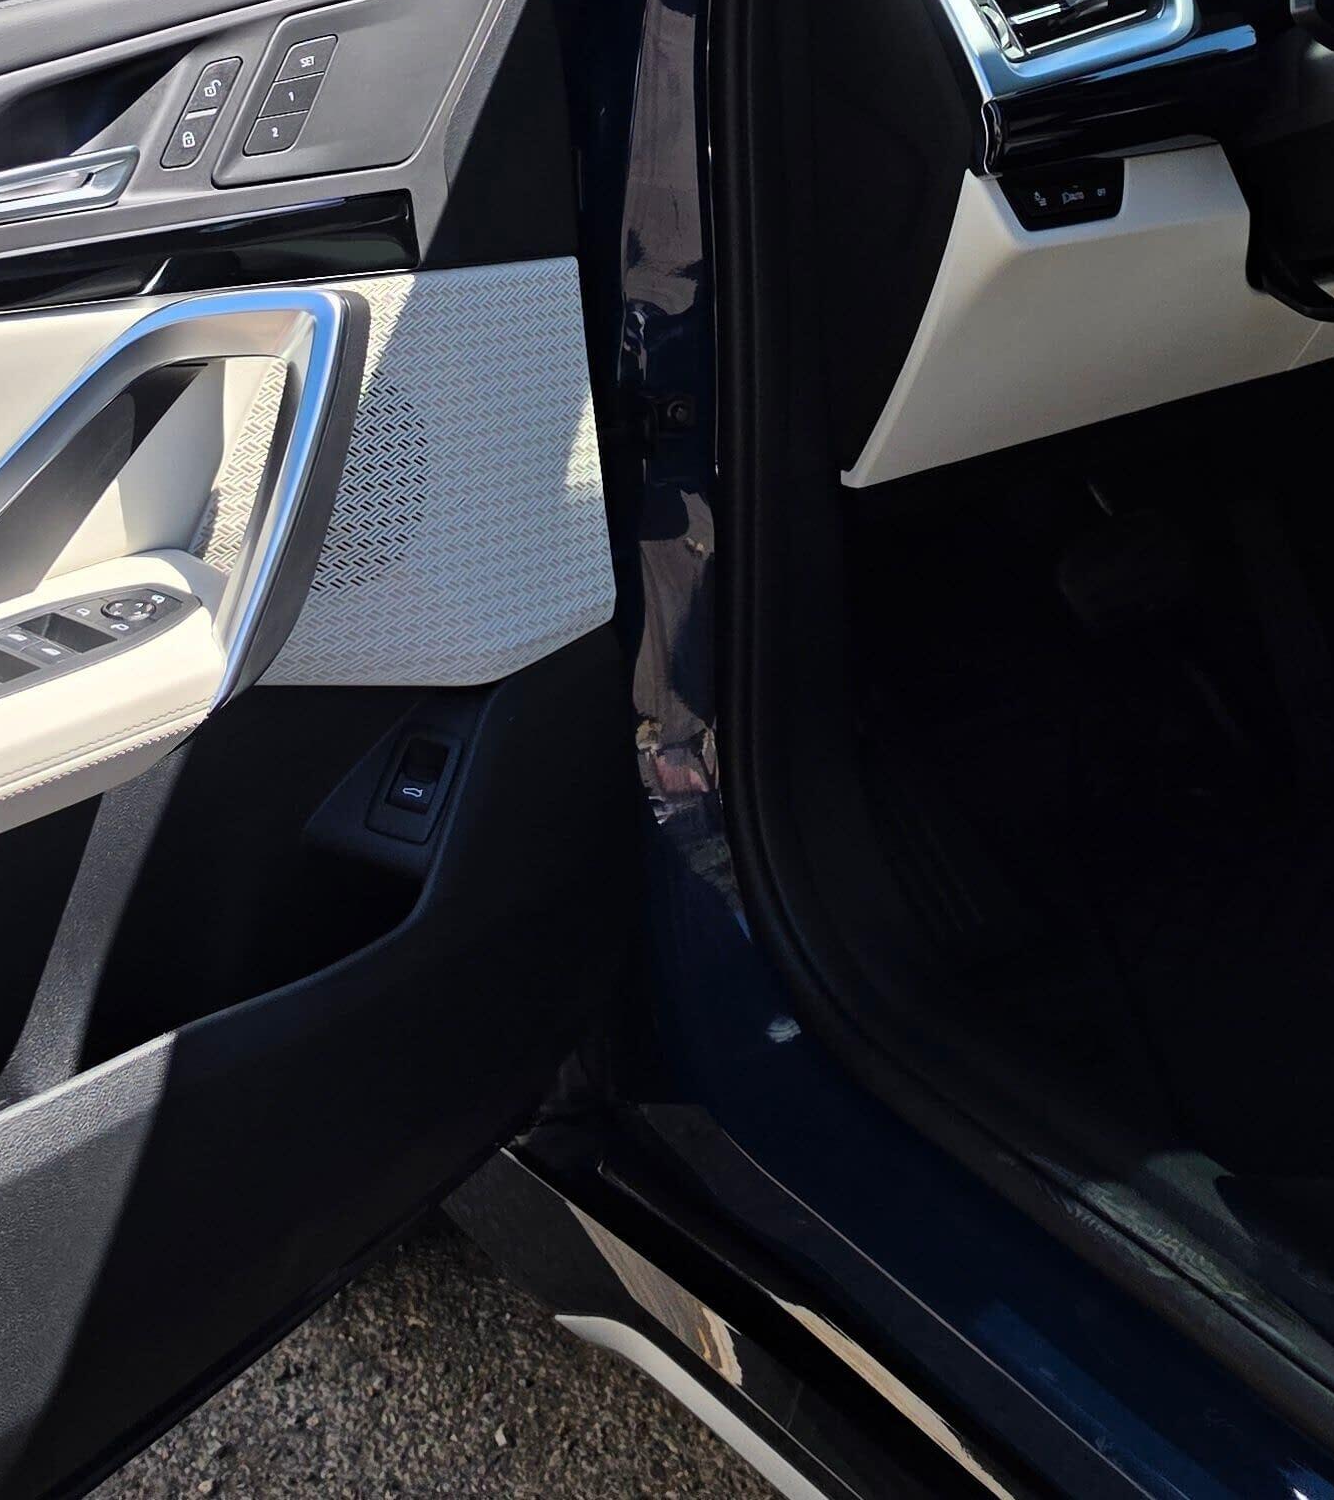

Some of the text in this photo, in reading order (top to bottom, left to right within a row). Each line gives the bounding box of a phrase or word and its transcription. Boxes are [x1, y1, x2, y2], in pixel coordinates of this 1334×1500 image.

[299, 55, 315, 68] SET
[288, 91, 295, 102] 1
[271, 126, 280, 138] 2
